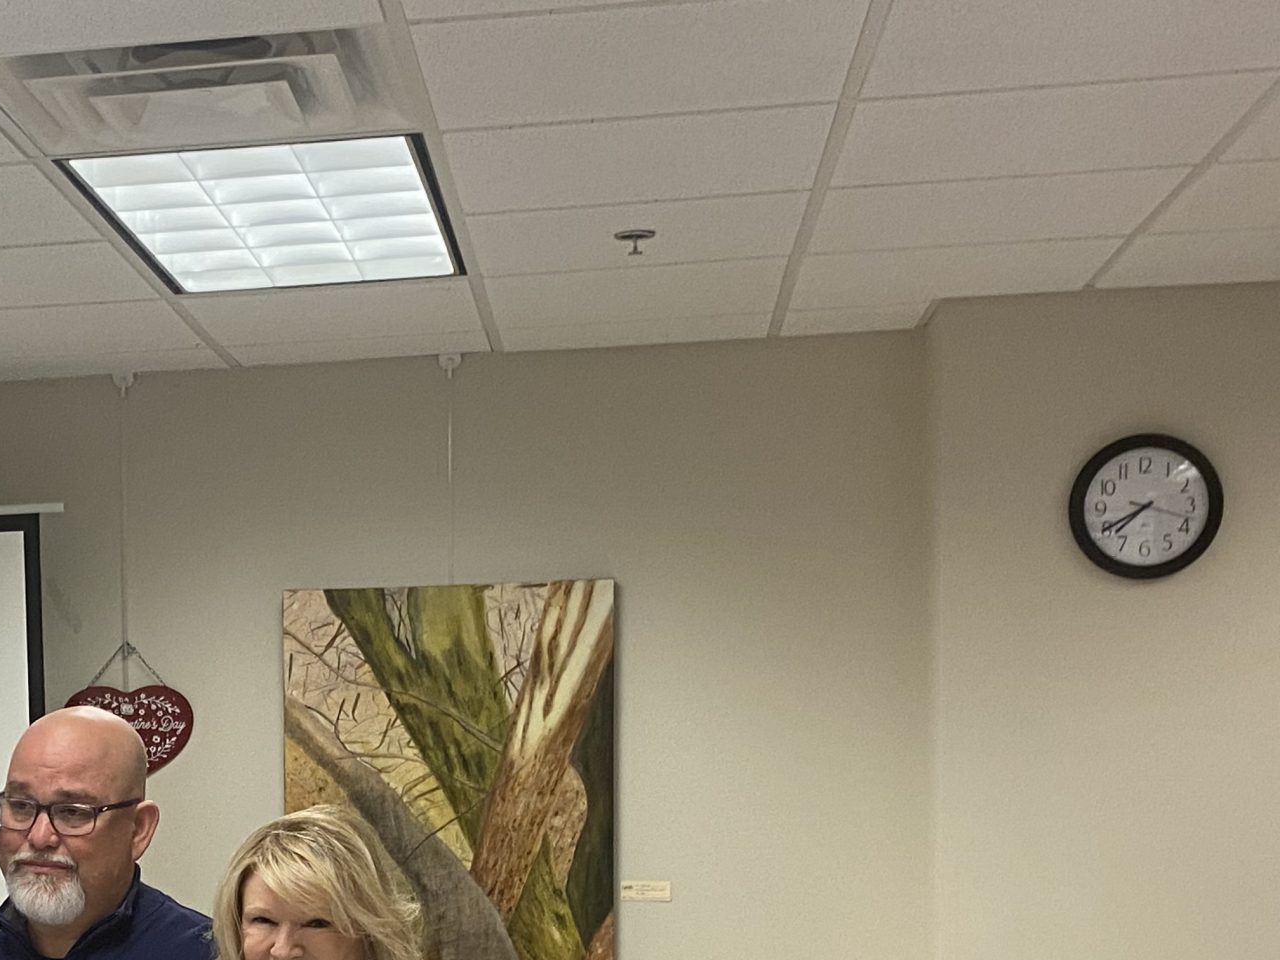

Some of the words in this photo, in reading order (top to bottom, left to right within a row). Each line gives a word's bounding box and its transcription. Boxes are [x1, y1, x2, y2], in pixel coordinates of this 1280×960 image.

[1119, 463, 1128, 480] 11
[1139, 457, 1152, 473] 12
[1166, 462, 1170, 478] 1
[1101, 479, 1116, 496] 10
[1181, 479, 1189, 493] 2
[1095, 502, 1106, 517] 9
[1185, 497, 1195, 513] 3
[1178, 518, 1189, 535] 4
[1118, 535, 1128, 552] 7
[1139, 540, 1150, 557] 6
[1163, 534, 1172, 551] 5
[158, 715, 186, 735] Day
